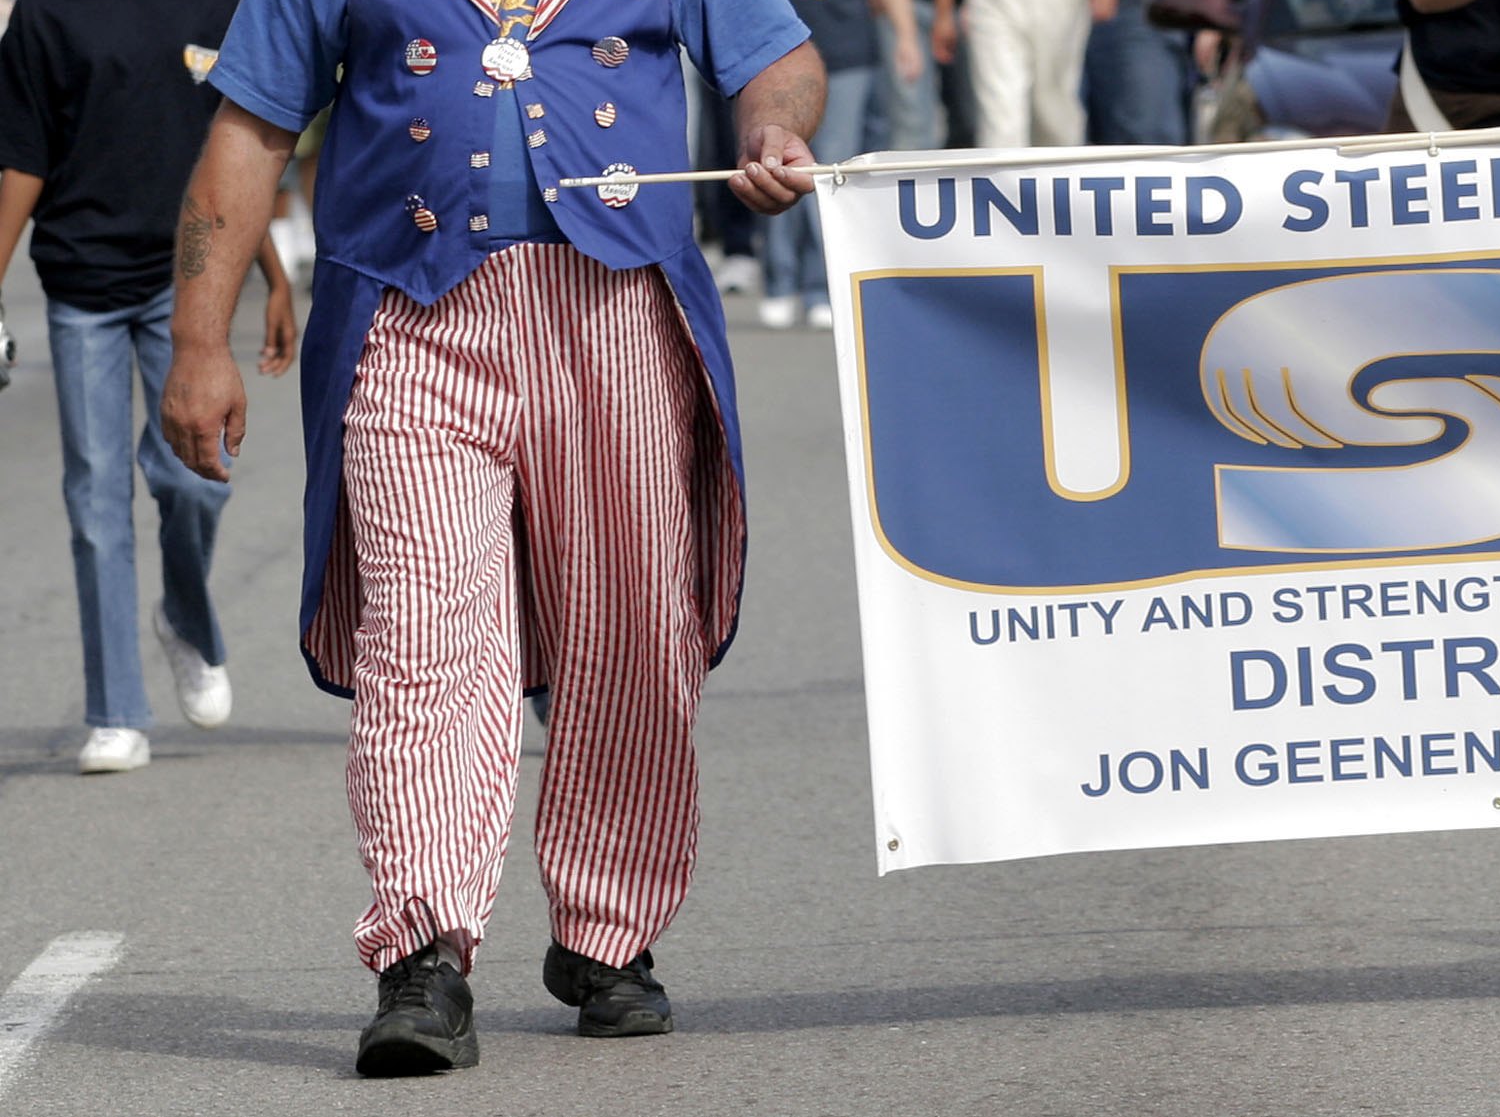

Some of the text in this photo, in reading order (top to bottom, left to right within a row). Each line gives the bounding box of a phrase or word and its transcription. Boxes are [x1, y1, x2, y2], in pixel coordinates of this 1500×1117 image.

[897, 175, 1243, 240] UNITED
[968, 598, 1125, 646] UNITY
[1141, 590, 1254, 633] AND
[1081, 747, 1211, 798] JON
